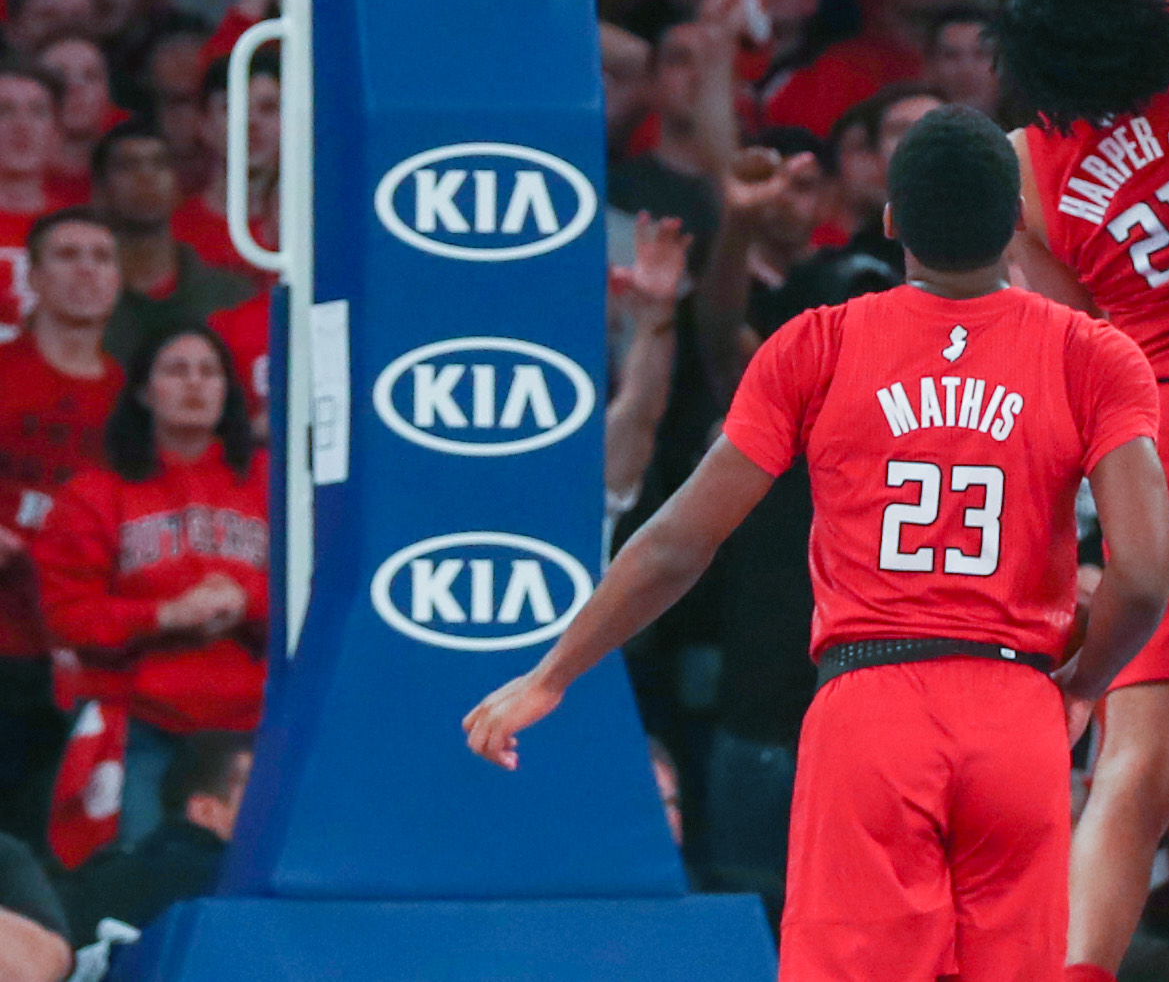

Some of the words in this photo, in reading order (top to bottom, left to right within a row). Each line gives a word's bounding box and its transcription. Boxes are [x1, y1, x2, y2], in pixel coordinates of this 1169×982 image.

[414, 169, 560, 234] KIA
[1058, 116, 1165, 225] HARPER
[411, 364, 559, 429] KIA
[876, 376, 1024, 442] MATHIS
[879, 459, 1006, 577] 23
[410, 559, 557, 624] KIA
